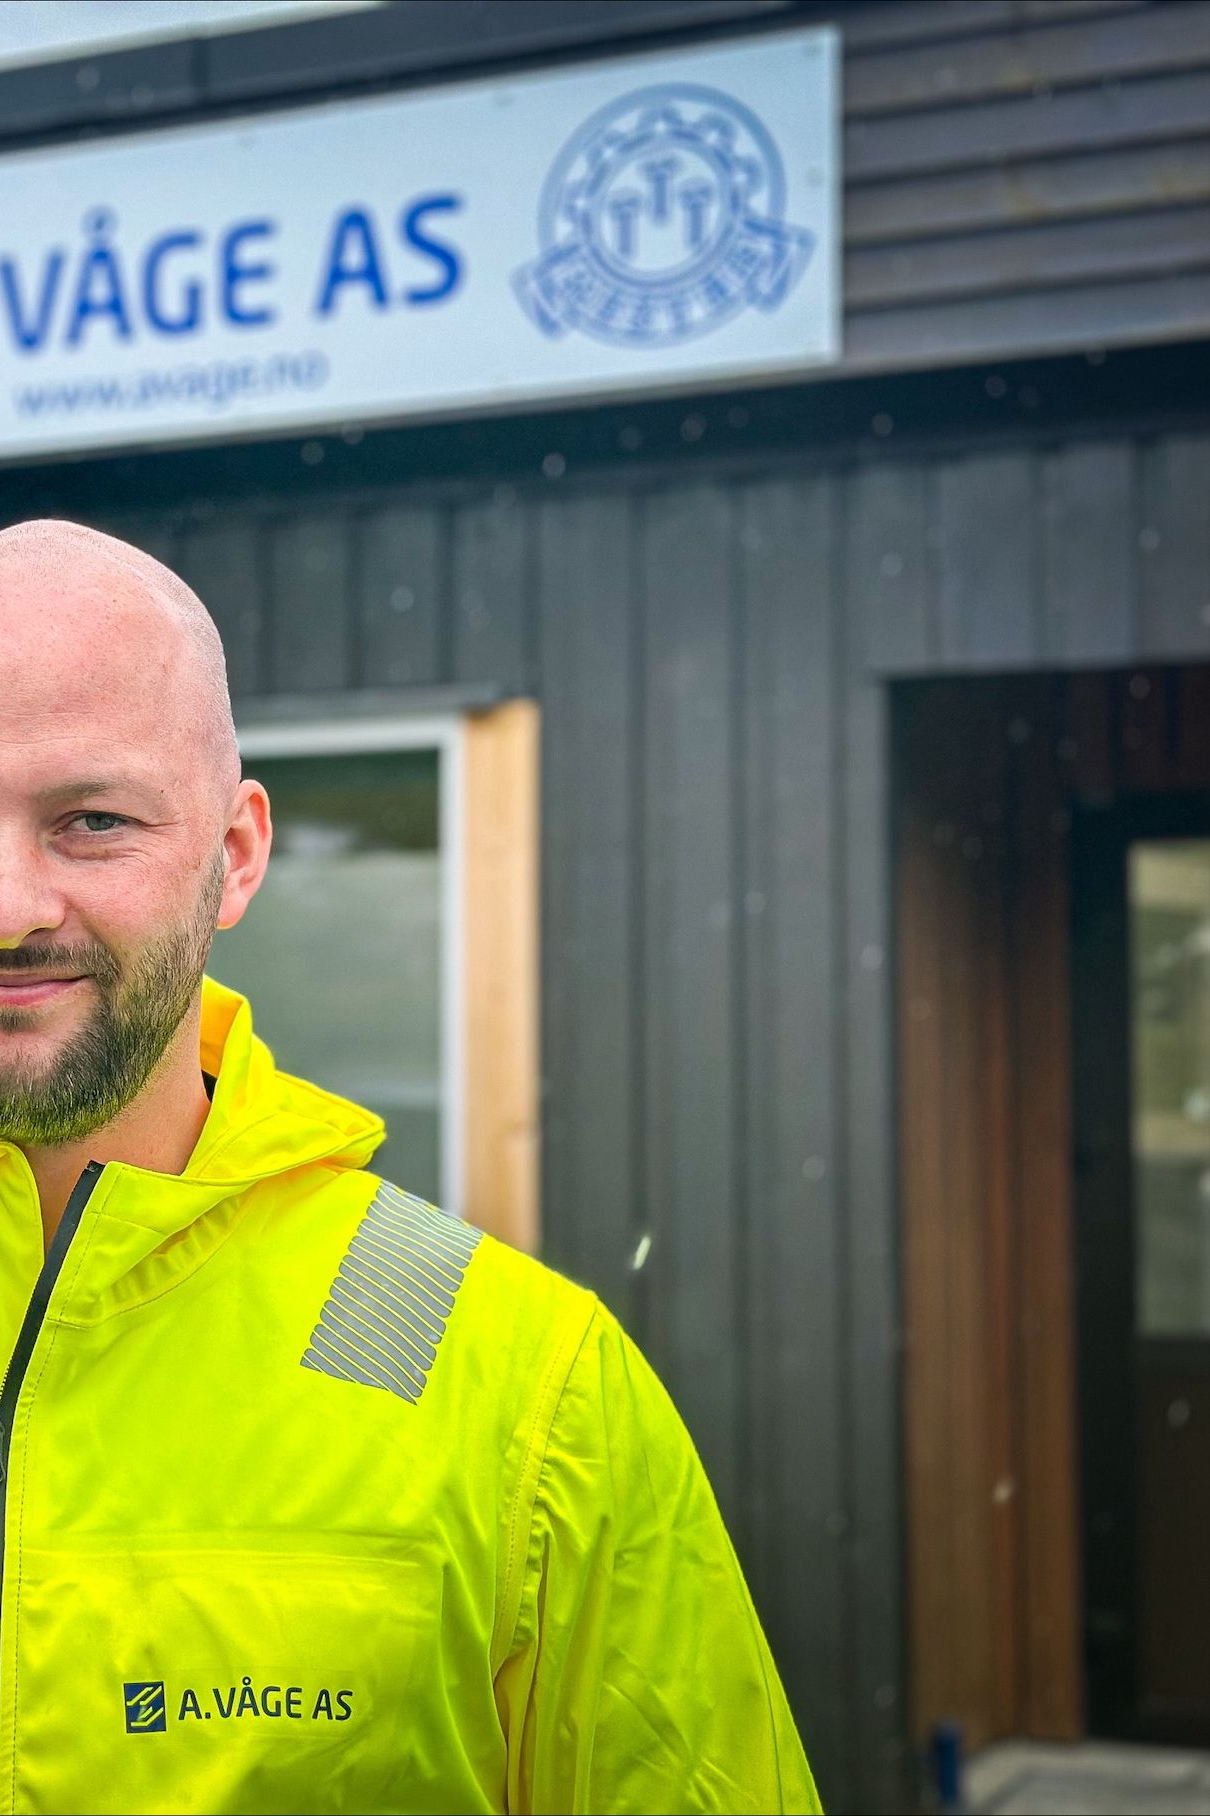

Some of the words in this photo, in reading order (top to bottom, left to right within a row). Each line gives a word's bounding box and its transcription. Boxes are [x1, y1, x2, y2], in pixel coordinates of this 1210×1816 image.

[316, 193, 465, 319] AS
[178, 1676, 302, 1720] A.VÅGE
[312, 1689, 353, 1721] AS
